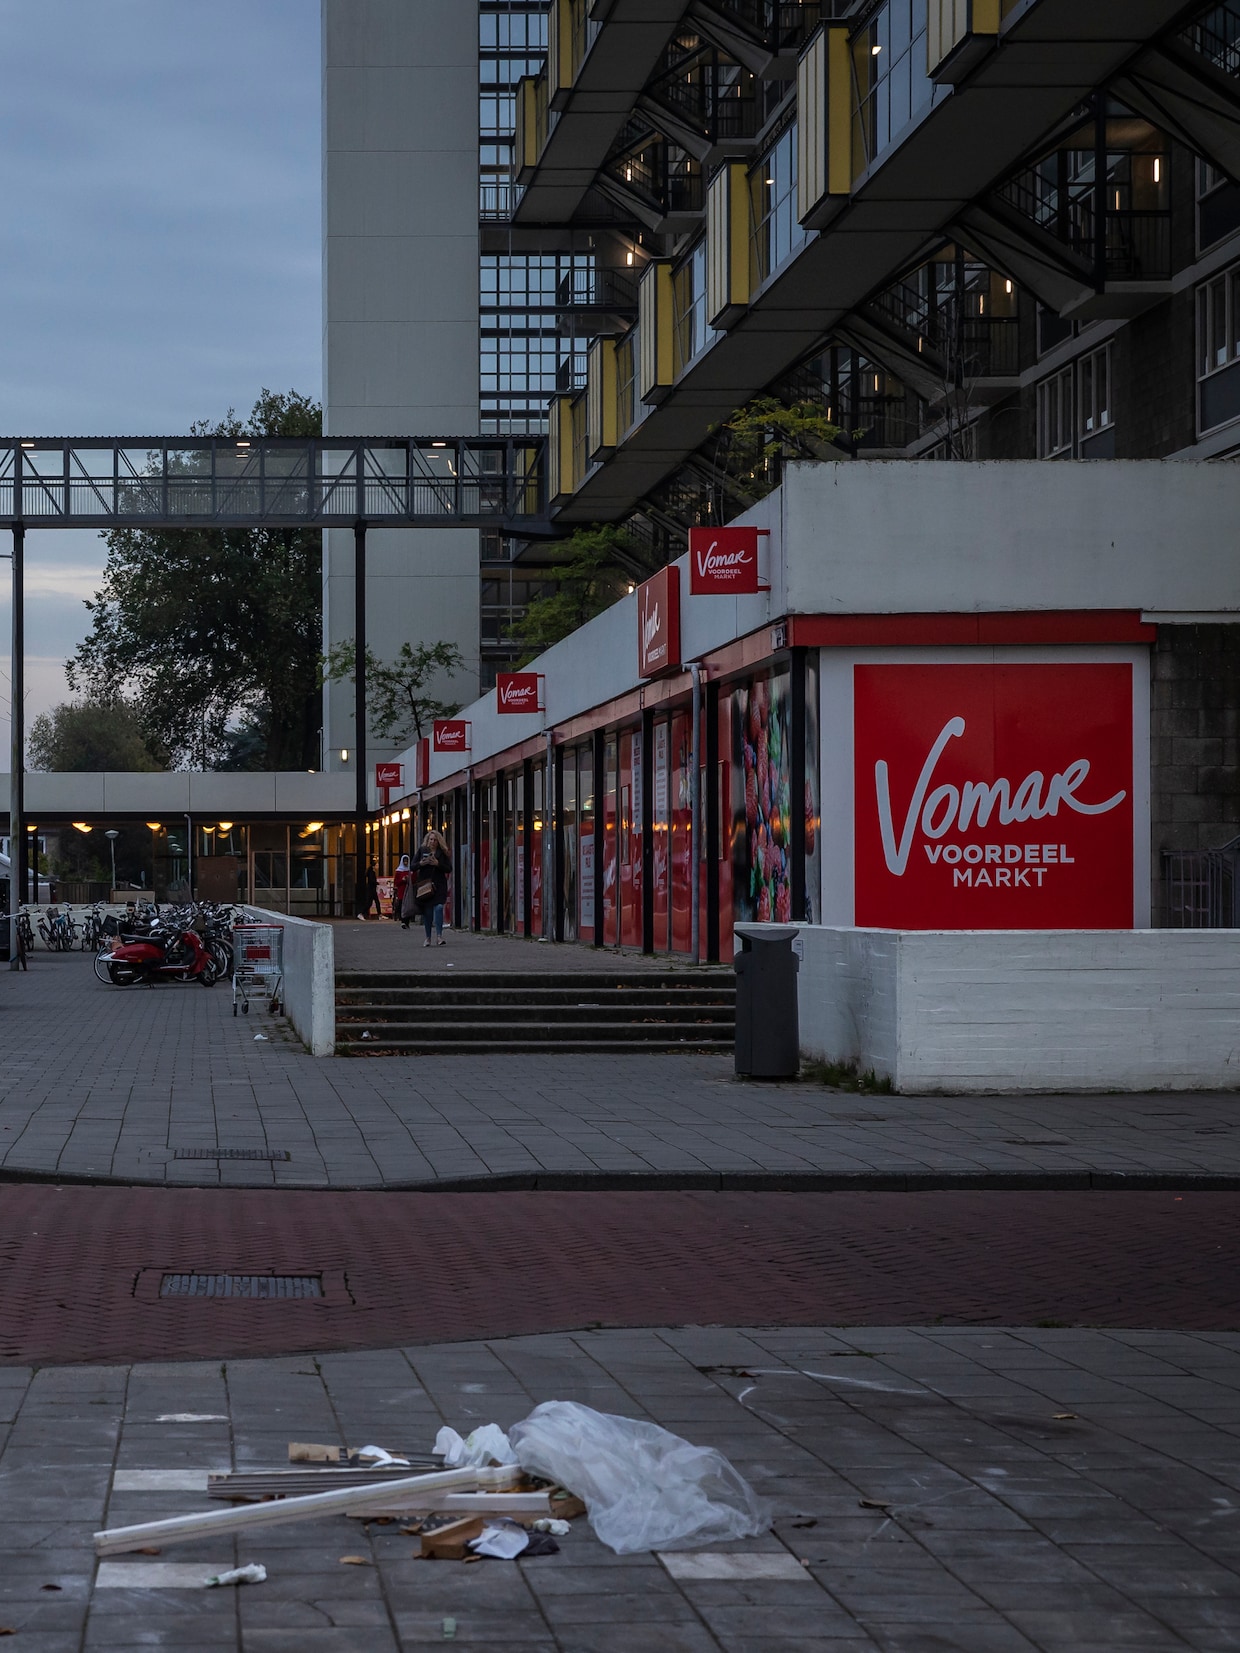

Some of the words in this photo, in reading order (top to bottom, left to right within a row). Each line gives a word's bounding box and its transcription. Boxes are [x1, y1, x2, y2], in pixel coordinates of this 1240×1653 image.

[697, 541, 753, 577] Vomar
[875, 716, 1126, 876] Vomar
[924, 844, 1075, 864] VOORDEEL
[953, 867, 1048, 887] MARKT
